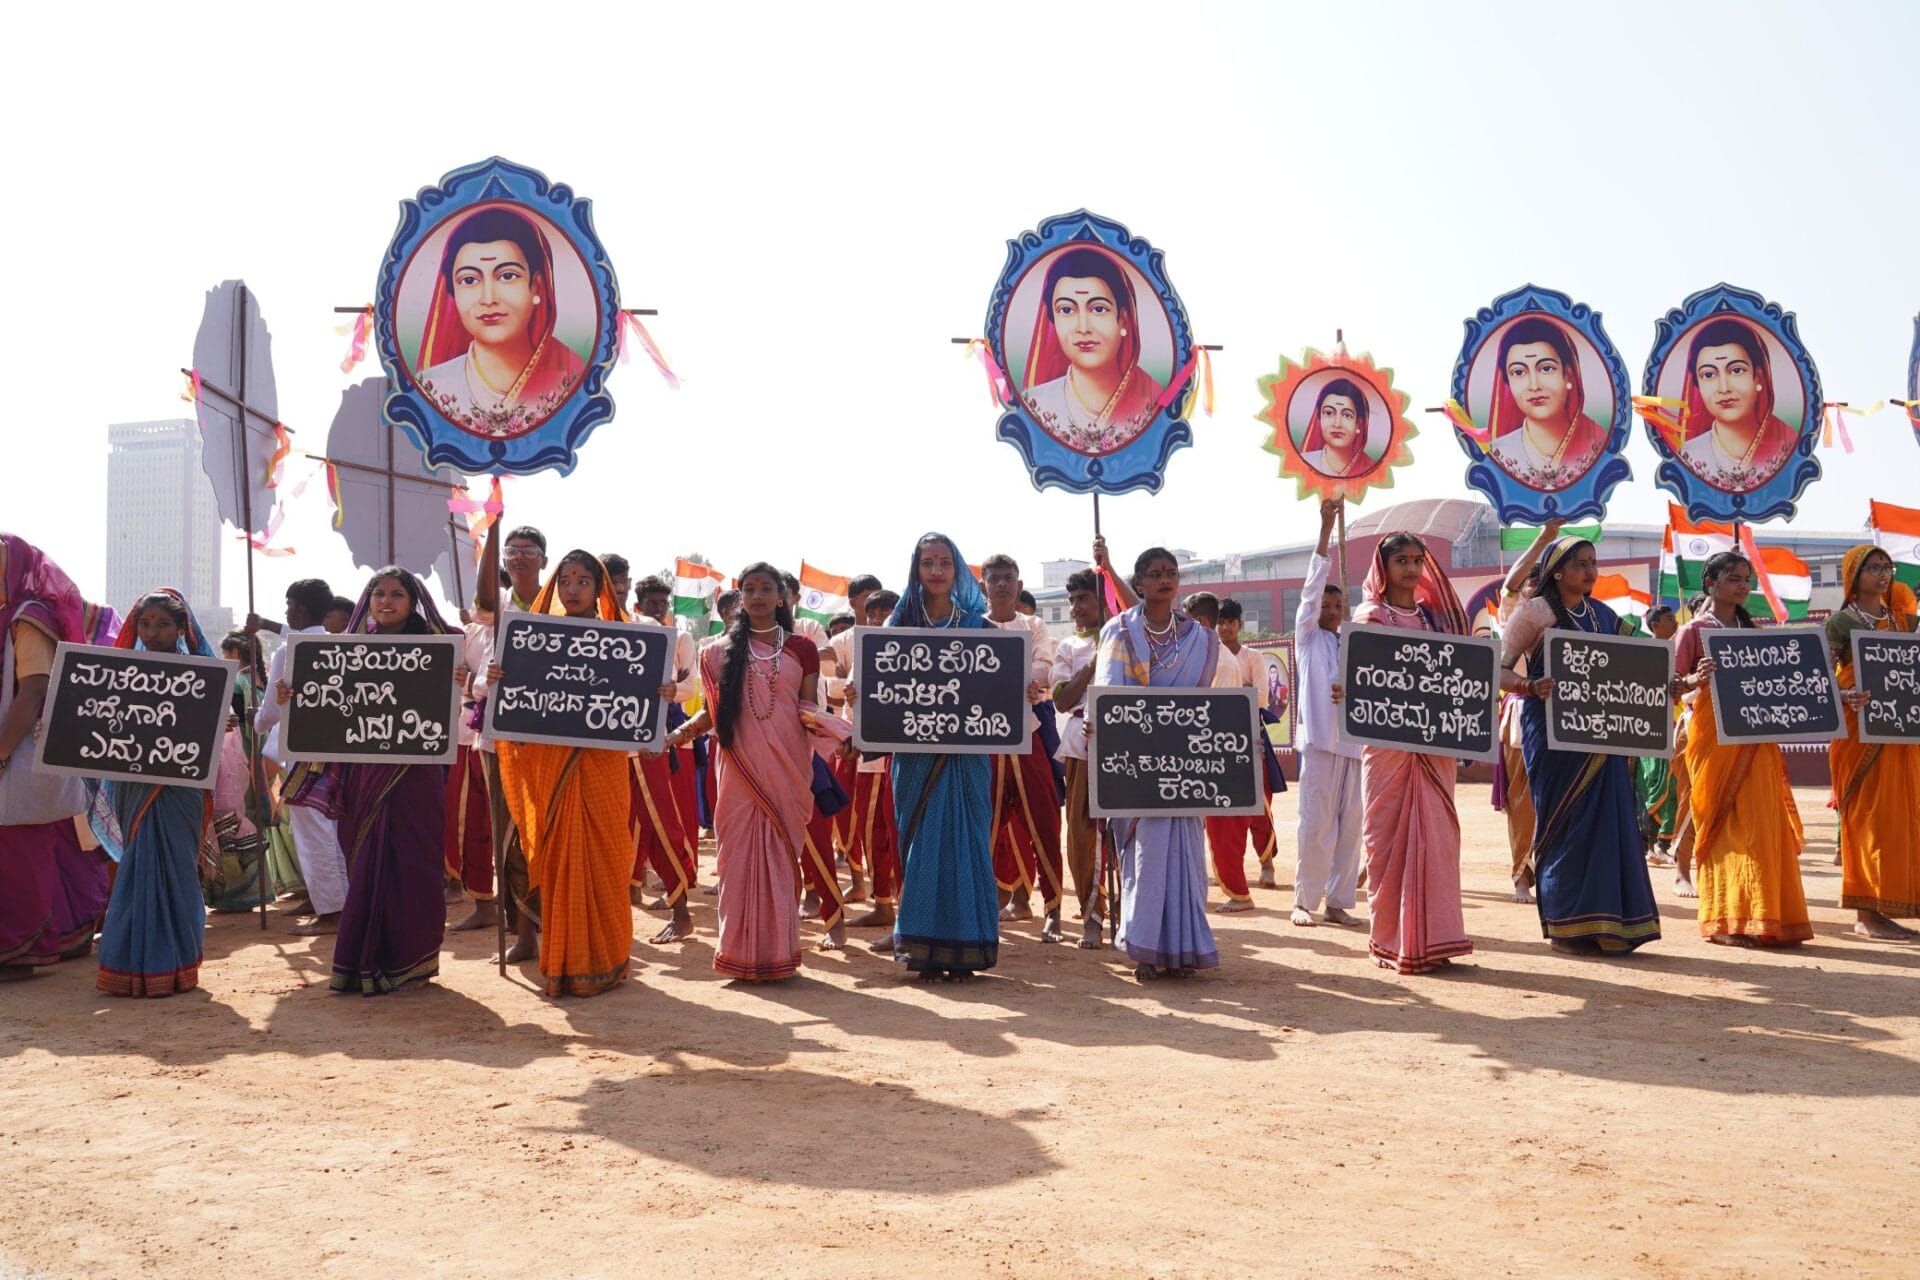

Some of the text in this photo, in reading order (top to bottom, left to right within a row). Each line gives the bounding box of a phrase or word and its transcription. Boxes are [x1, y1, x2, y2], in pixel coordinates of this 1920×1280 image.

[312, 644, 432, 675] ಮಾತೆಯರೇ
[512, 625, 647, 676] ಕಲಿತ ಹೆಣ್ಣು
[875, 640, 1000, 674] ಕೊಡಿ ಕೊಡಿ
[1394, 642, 1454, 672] ವಿದ್ಯೆಗೆ
[1562, 642, 1609, 680] ಶಿಕ್ಷಣ
[70, 663, 206, 699] ಮಾತೆಯರೇ
[546, 663, 608, 686] ನಮ್ಮ
[869, 678, 960, 706] ಅವಳಿಗೆ
[1356, 664, 1490, 706] ಗಂಡು ಹೆಣ್ಣೆಂಬ
[296, 675, 398, 716] ವಿದ್ಯೆಗಾಗಿ
[499, 686, 652, 741] ಸಮಾಜದ ಕಣ್ಣು
[77, 695, 177, 734] ವಿದ್ಯೆಗಾಗಿ
[346, 714, 394, 750] ಎದ್ದು
[903, 704, 1011, 742] ಶಿಕ್ಷಣ ಕೊಡಿ
[1104, 700, 1211, 734] ವಿದ್ಯೆ ಕಲಿತ
[1350, 697, 1437, 742] ತಾರತಮ್ಯ
[1869, 700, 1905, 732] ನಿನ್ನ
[80, 732, 200, 776] ಎದ್ದು ನಿಲ್ಲಿ
[1188, 728, 1250, 764] ಹೆಣ್ಣು
[1102, 751, 1226, 778] ತನ್ನ ಕುಟುಂಬದ
[1158, 774, 1231, 808] ಕಣ್ಣು
